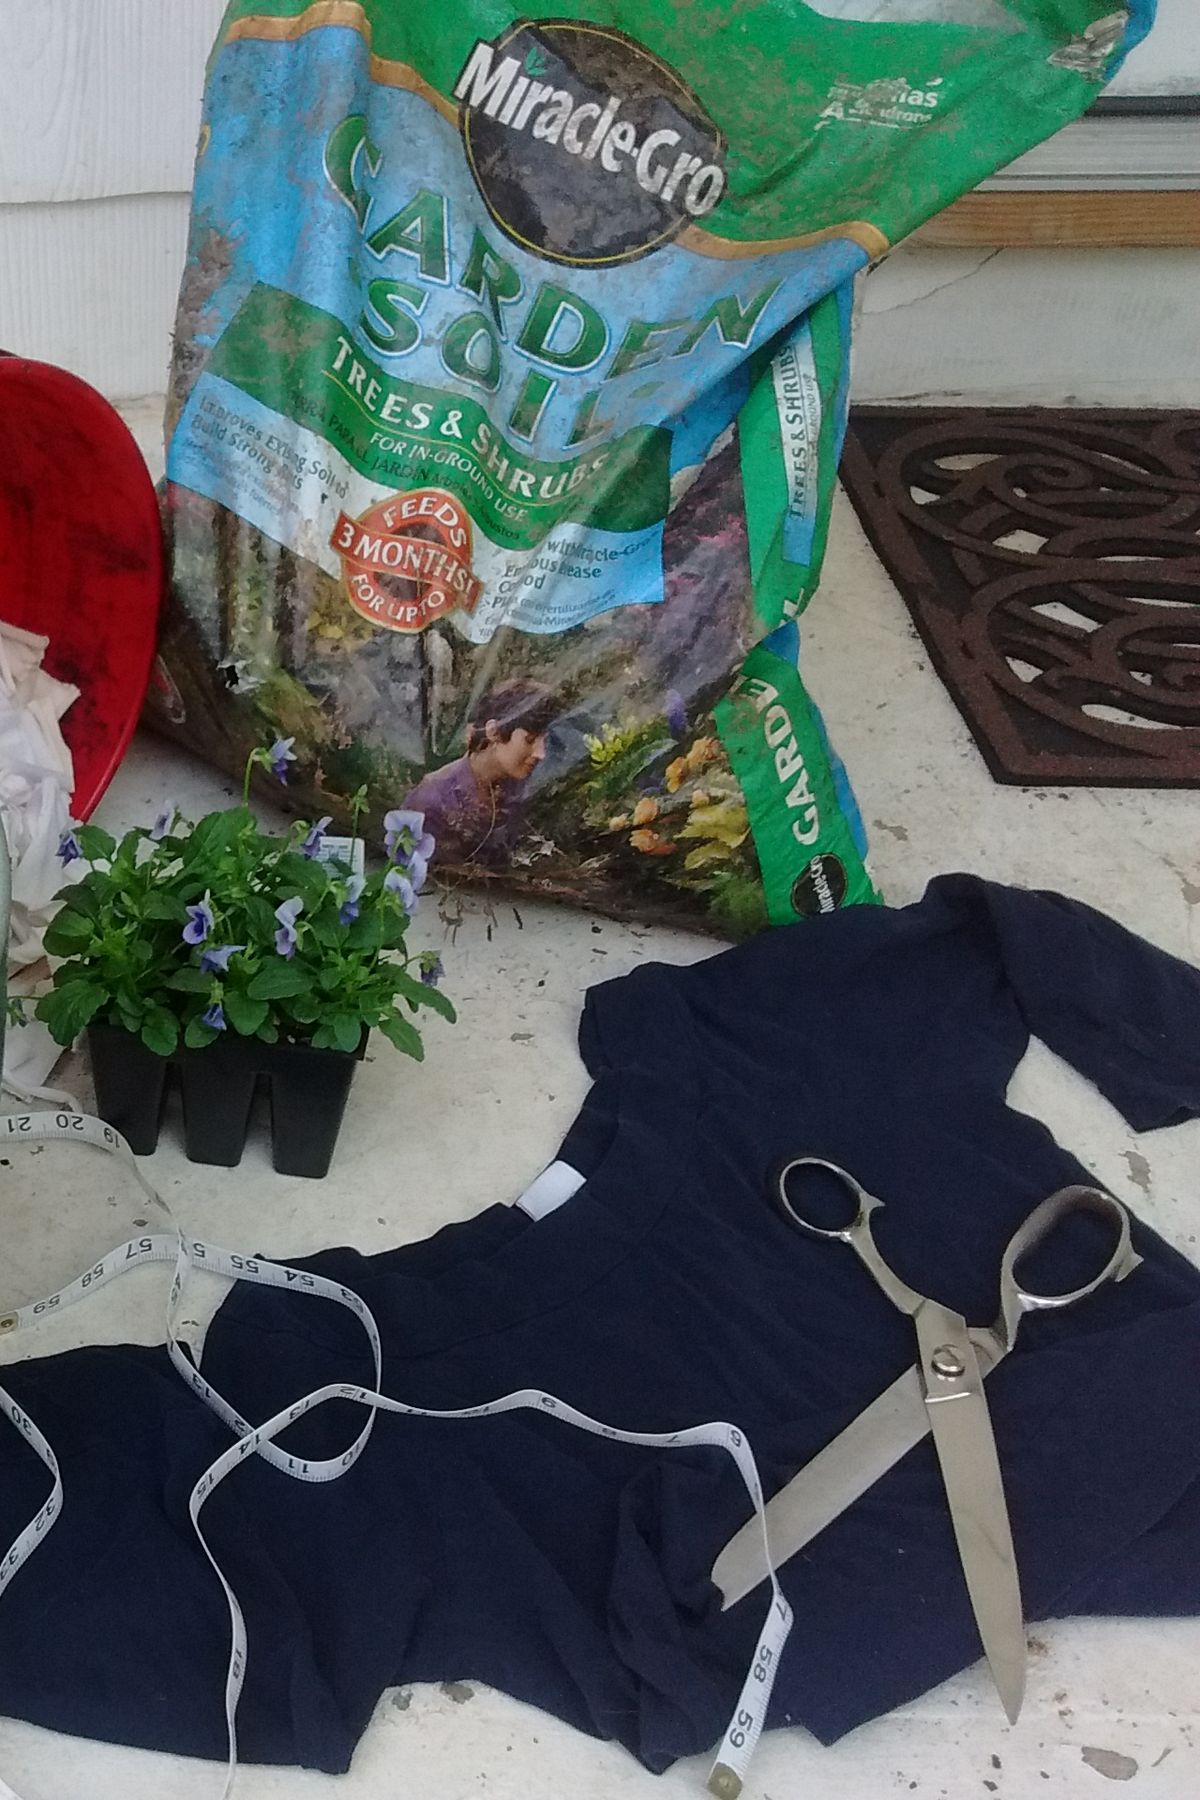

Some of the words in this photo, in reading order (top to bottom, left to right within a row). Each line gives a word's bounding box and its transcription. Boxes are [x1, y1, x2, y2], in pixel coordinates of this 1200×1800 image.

[453, 41, 725, 216] Miracle-Gro
[322, 114, 785, 383] GARDEN
[780, 344, 804, 430] SHRUBS
[331, 336, 434, 430] TREES
[440, 410, 463, 439] &
[470, 422, 609, 499] SHRUBS
[791, 431, 806, 442] &
[228, 433, 272, 475] Strong
[369, 431, 408, 456] FOR
[408, 444, 494, 500] IN-GROUND
[494, 498, 529, 523] USE
[789, 447, 807, 521] TREES
[382, 497, 467, 548] FEEDS
[338, 523, 355, 548] 3
[351, 573, 385, 612] FOR
[387, 602, 418, 622] UP
[418, 590, 446, 616] TO
[7, 1116, 32, 1133] 21
[56, 1113, 85, 1131] 20
[103, 1127, 121, 1149] 19
[125, 1237, 153, 1260] 57
[192, 1242, 206, 1258] 5
[81, 1262, 105, 1288] 58
[230, 1254, 260, 1274] 55
[283, 1268, 315, 1288] 54
[32, 1293, 61, 1315] 59
[287, 1457, 310, 1474] 11
[775, 1601, 788, 1622] 7
[753, 1644, 774, 1684] 58
[728, 1708, 754, 1749] 59
